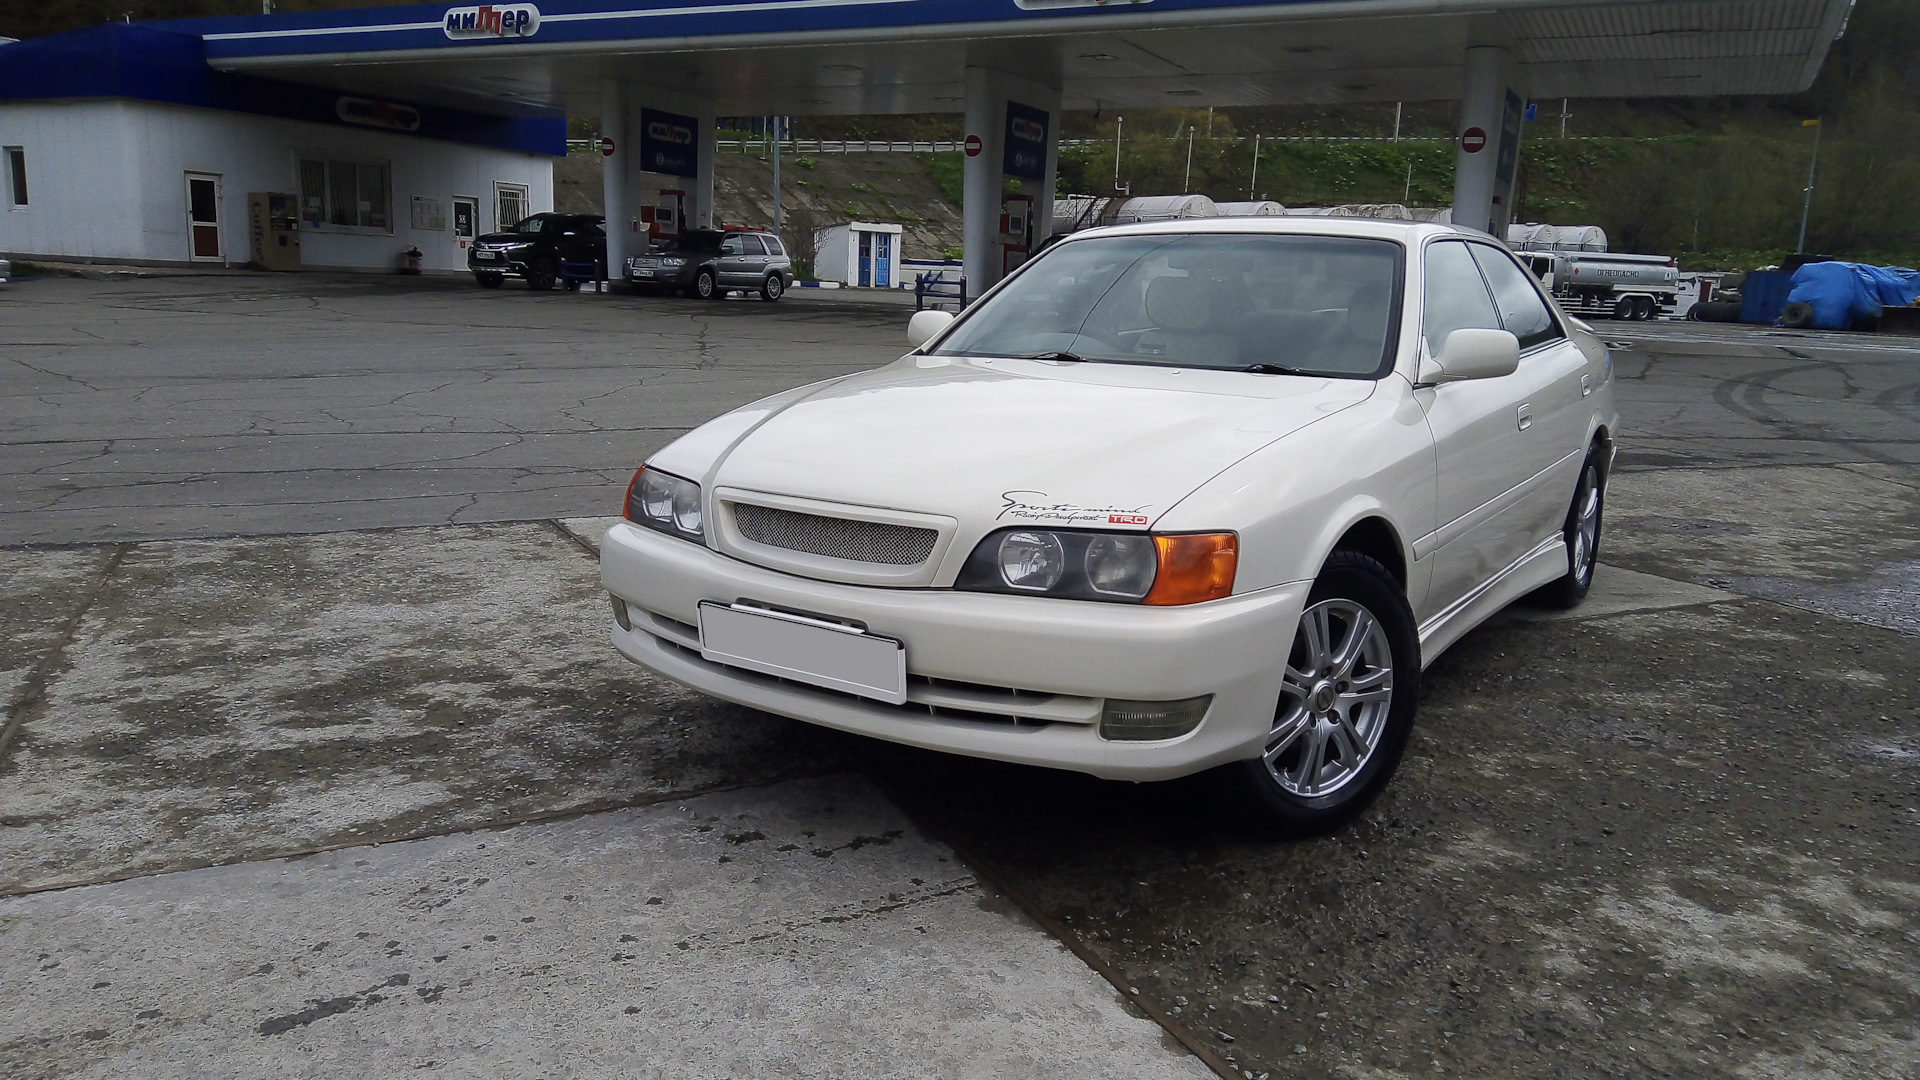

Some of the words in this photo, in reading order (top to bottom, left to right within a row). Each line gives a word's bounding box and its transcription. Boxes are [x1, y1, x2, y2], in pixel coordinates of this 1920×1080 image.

[252, 202, 264, 255] Coffee
[1596, 268, 1640, 279] ОГНЕОПАСНО
[1110, 514, 1147, 525] TRD
